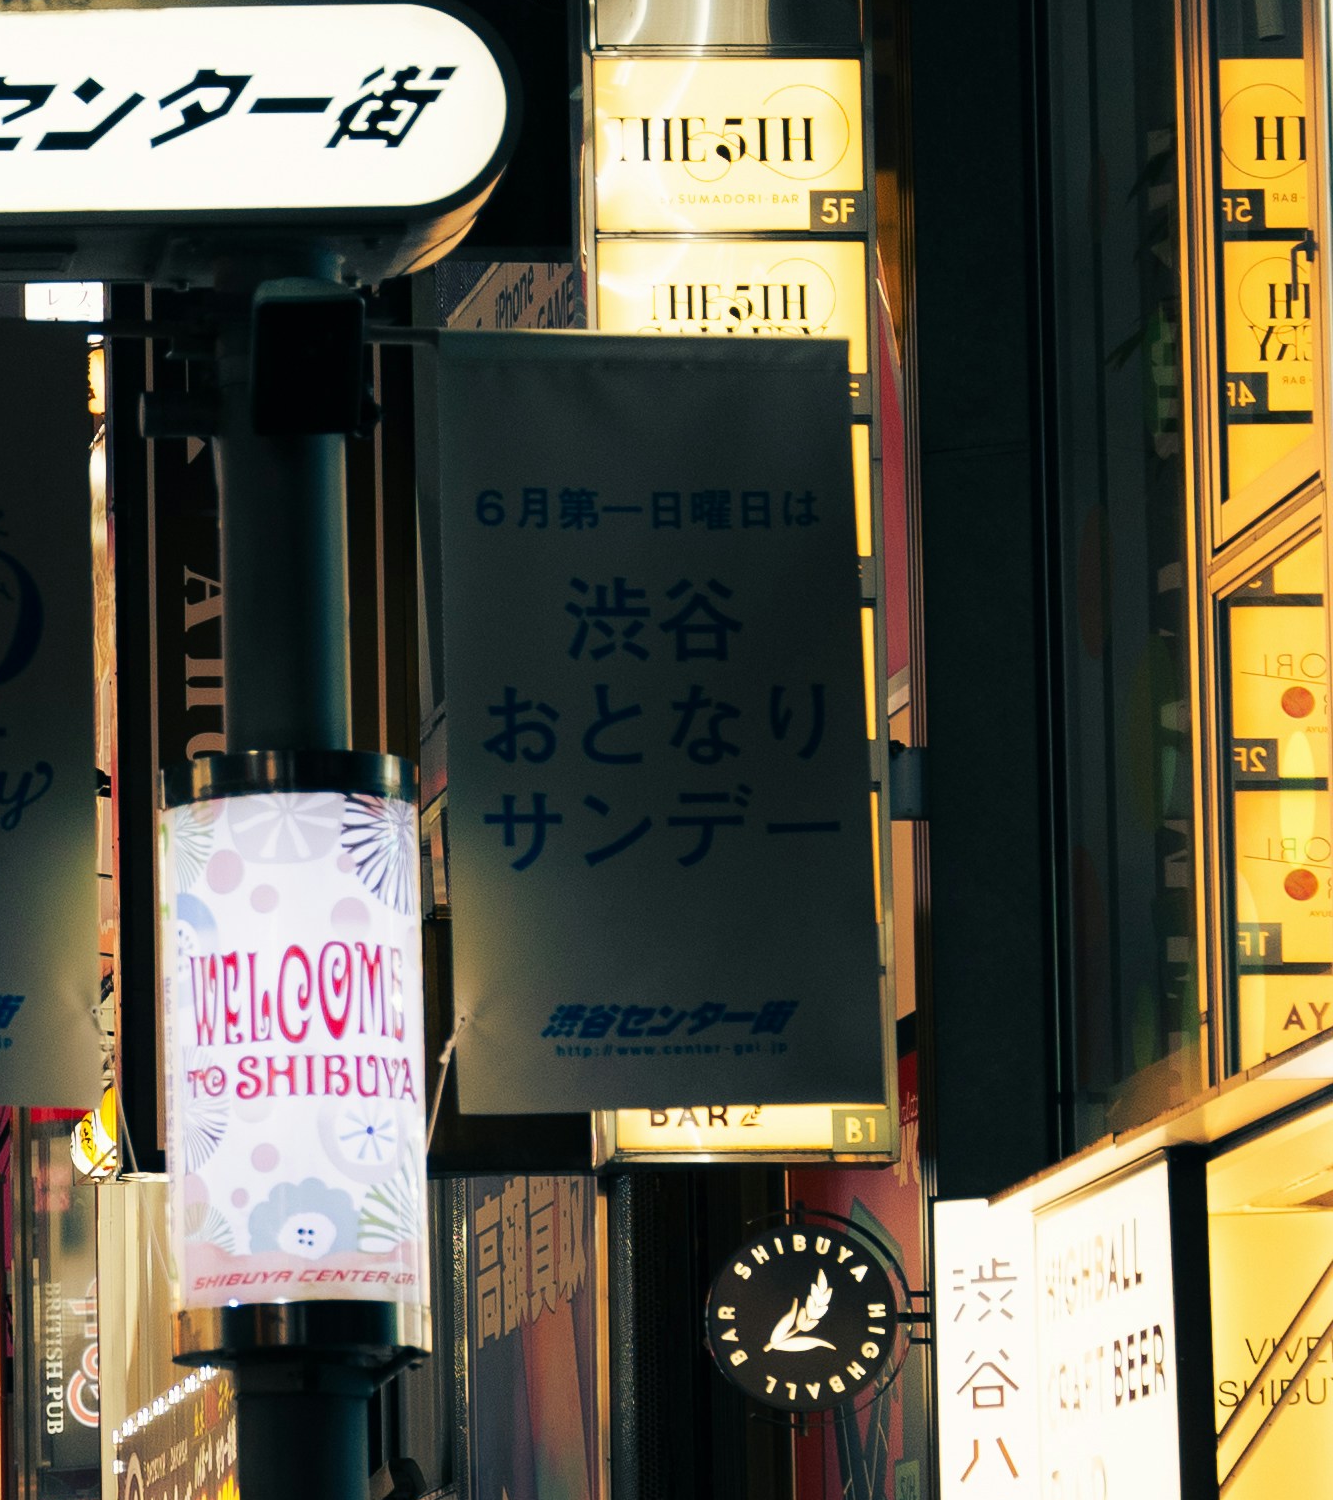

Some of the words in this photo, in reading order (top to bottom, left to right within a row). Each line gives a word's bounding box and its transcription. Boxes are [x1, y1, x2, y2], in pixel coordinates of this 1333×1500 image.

[608, 116, 707, 162] THE
[715, 116, 815, 162] 5TH
[820, 197, 856, 224] 5F
[645, 283, 721, 320] THE
[728, 283, 808, 320] 5TH
[476, 486, 822, 532] 6月第一日曜日は
[565, 576, 744, 664] 渋谷
[481, 684, 827, 768] おとなり
[482, 783, 843, 871] サンデー
[189, 940, 408, 1047] WELCOME
[541, 1000, 799, 1040] 渋谷センター街
[187, 1064, 227, 1098] TO
[235, 1055, 418, 1104] SHIBUYA
[844, 1116, 878, 1143] B1
[193, 1269, 293, 1292] SHIBUYA
[733, 1233, 869, 1283] SHIBUYA
[1045, 1217, 1144, 1323] HIGHBALL
[717, 1305, 749, 1367] BAR
[765, 1303, 887, 1400] HIGHBALL
[1113, 1323, 1167, 1408] BEER
